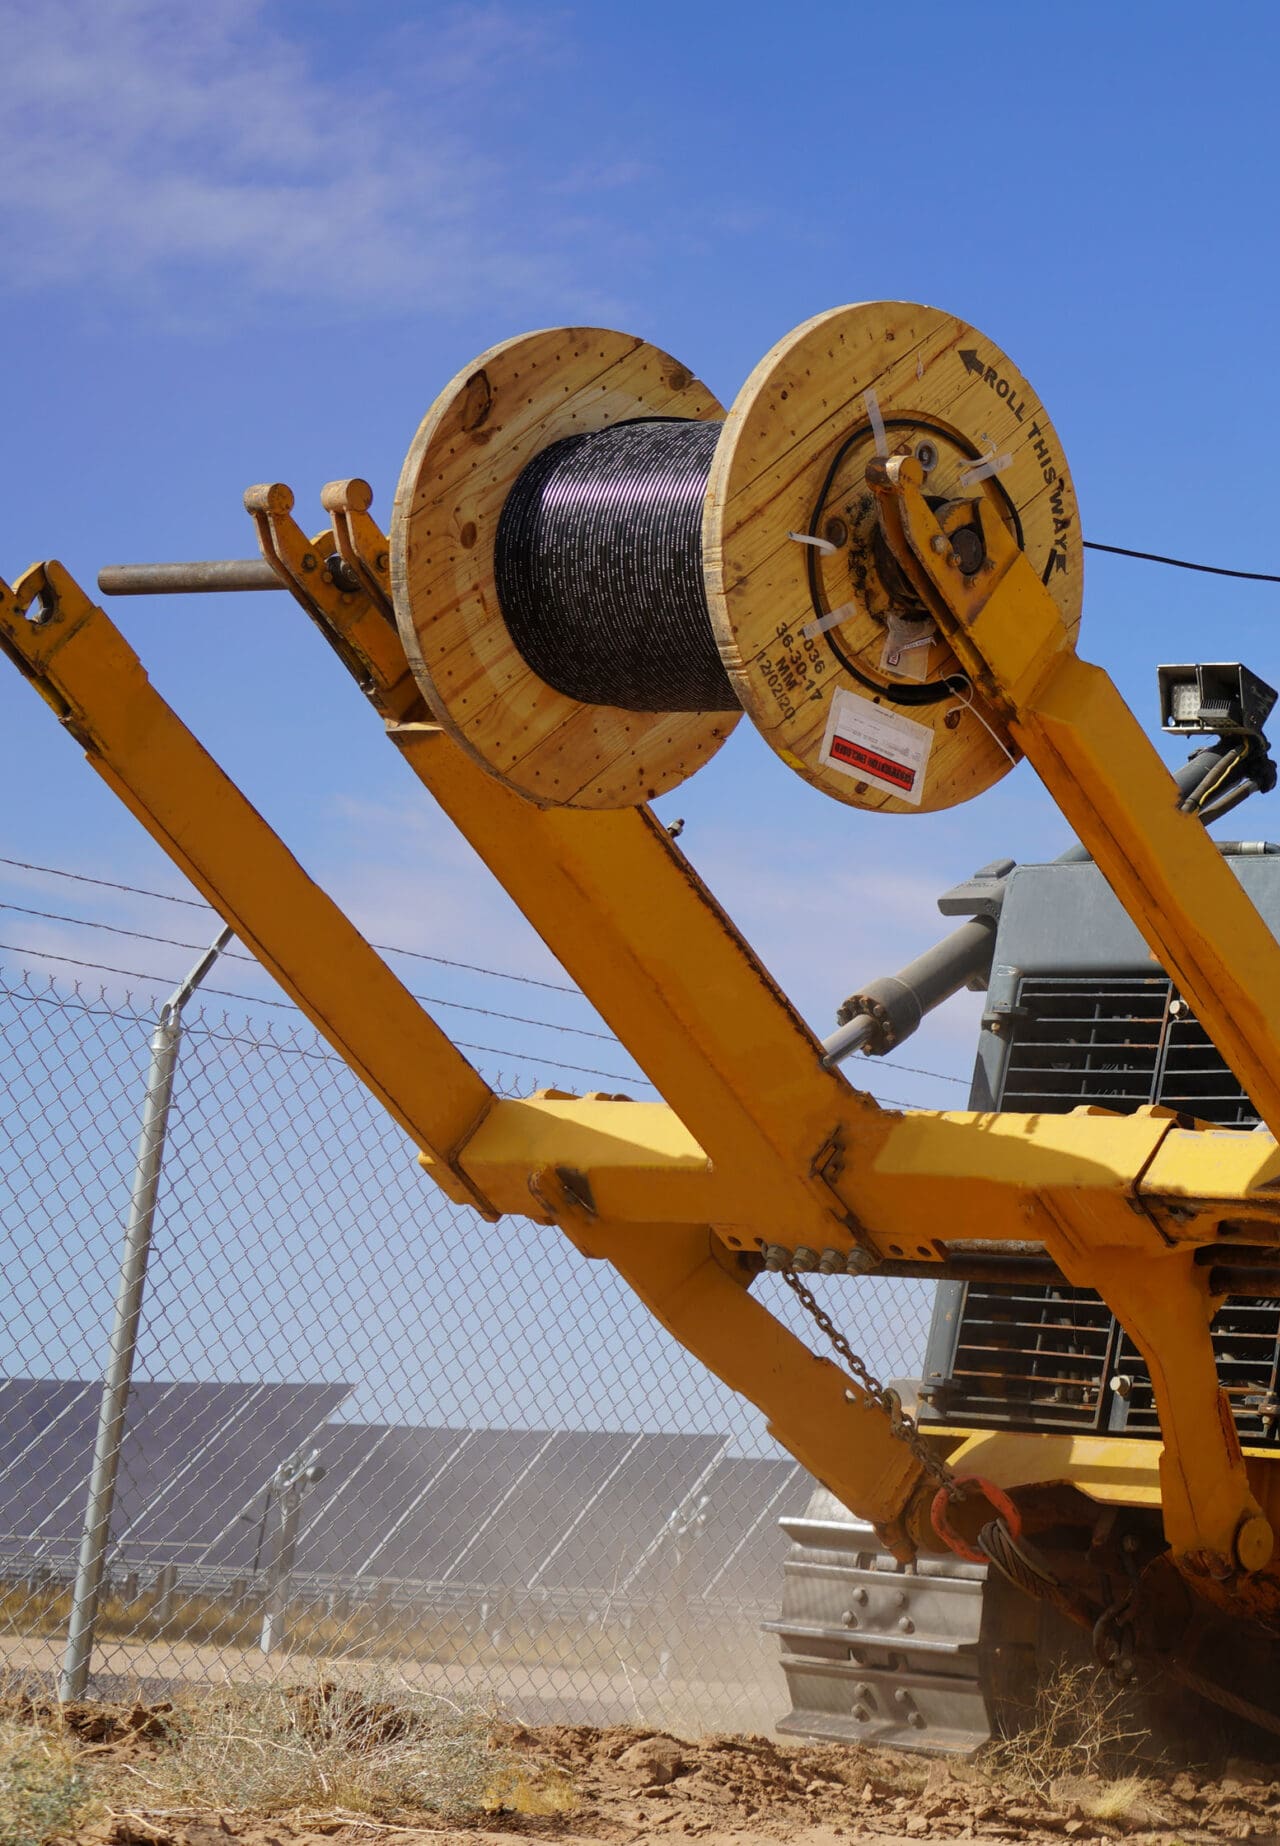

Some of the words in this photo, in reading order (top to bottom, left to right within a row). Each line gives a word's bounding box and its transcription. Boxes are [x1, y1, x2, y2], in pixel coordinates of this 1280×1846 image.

[983, 366, 1025, 422] ROLL
[1028, 421, 1056, 485] THIS
[1050, 490, 1070, 550] WAY
[756, 651, 796, 720] 12/02/20
[775, 656, 798, 692] MM
[776, 622, 823, 701] 36-30-17
